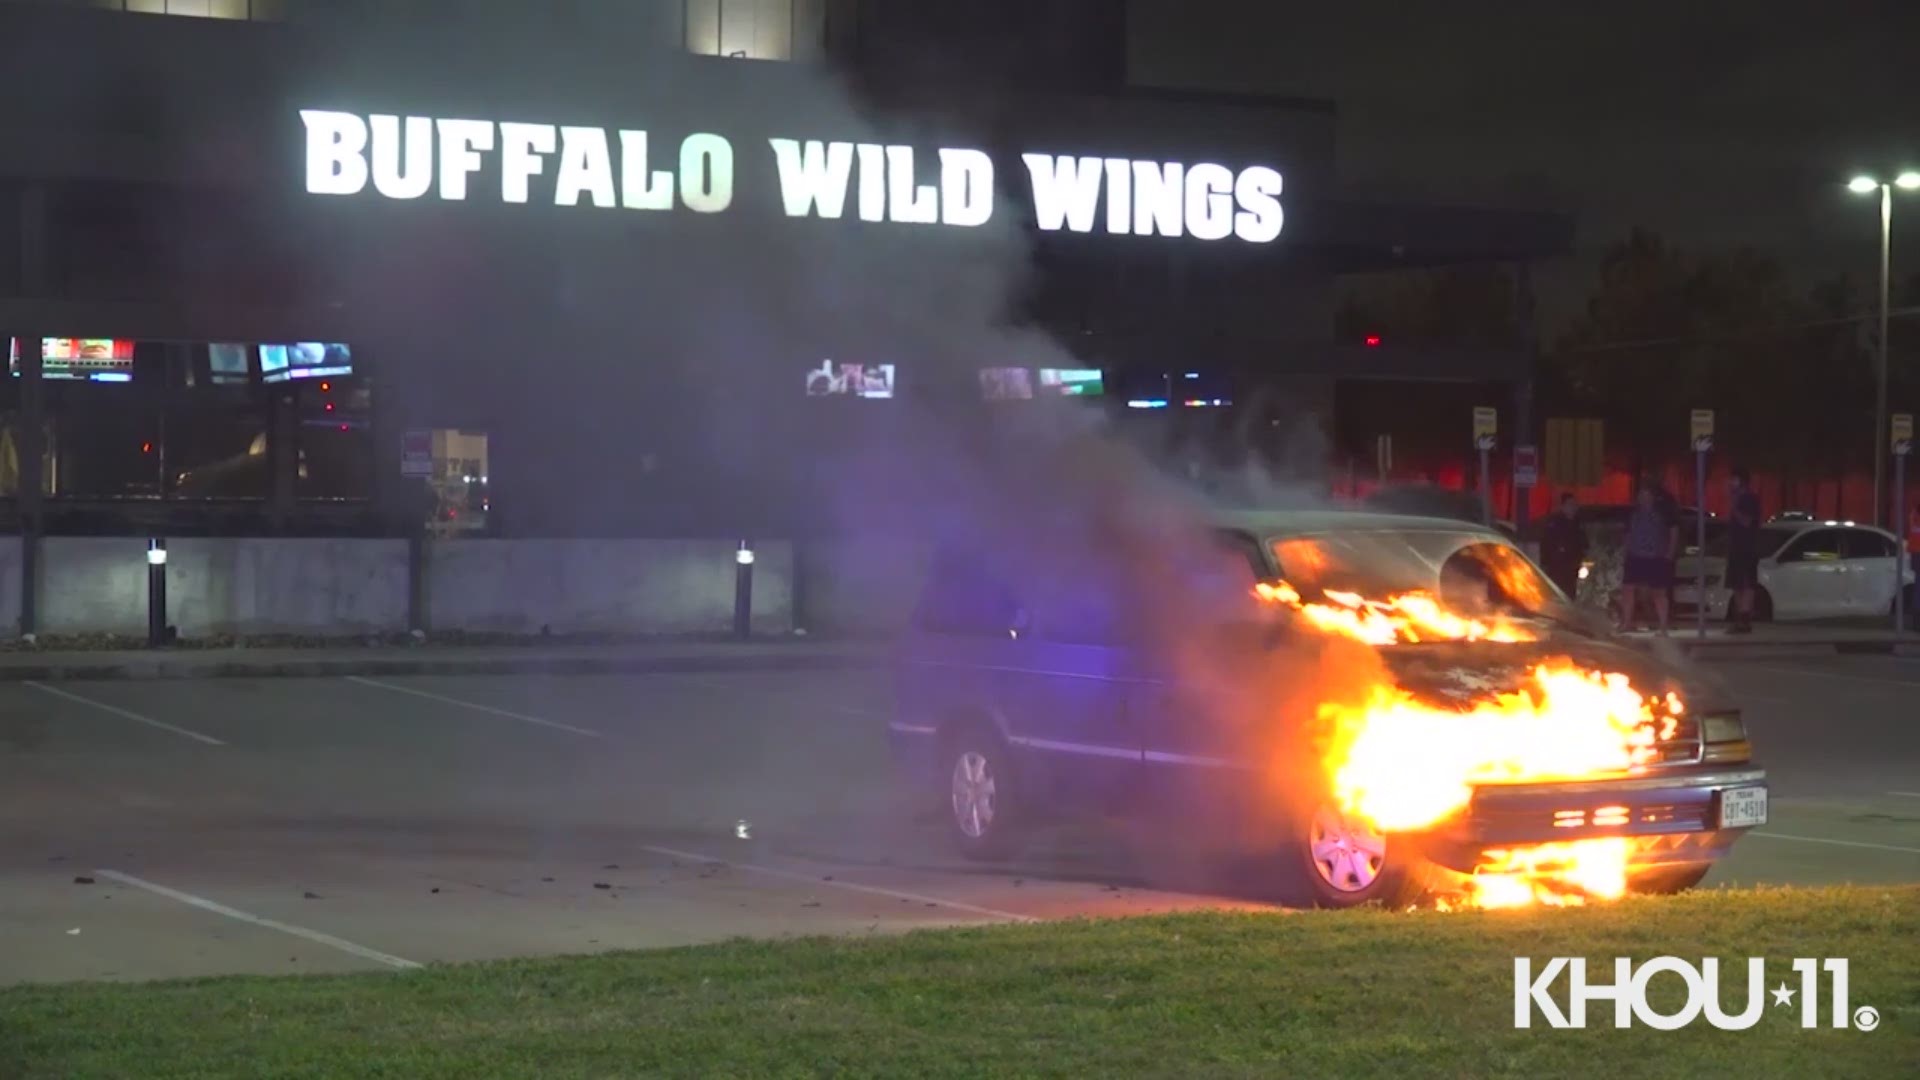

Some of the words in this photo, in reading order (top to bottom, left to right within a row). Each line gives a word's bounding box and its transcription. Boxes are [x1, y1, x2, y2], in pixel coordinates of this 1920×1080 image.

[300, 110, 733, 213] BUFFALO
[769, 138, 994, 227] WILD
[1022, 153, 1284, 243] WINGS
